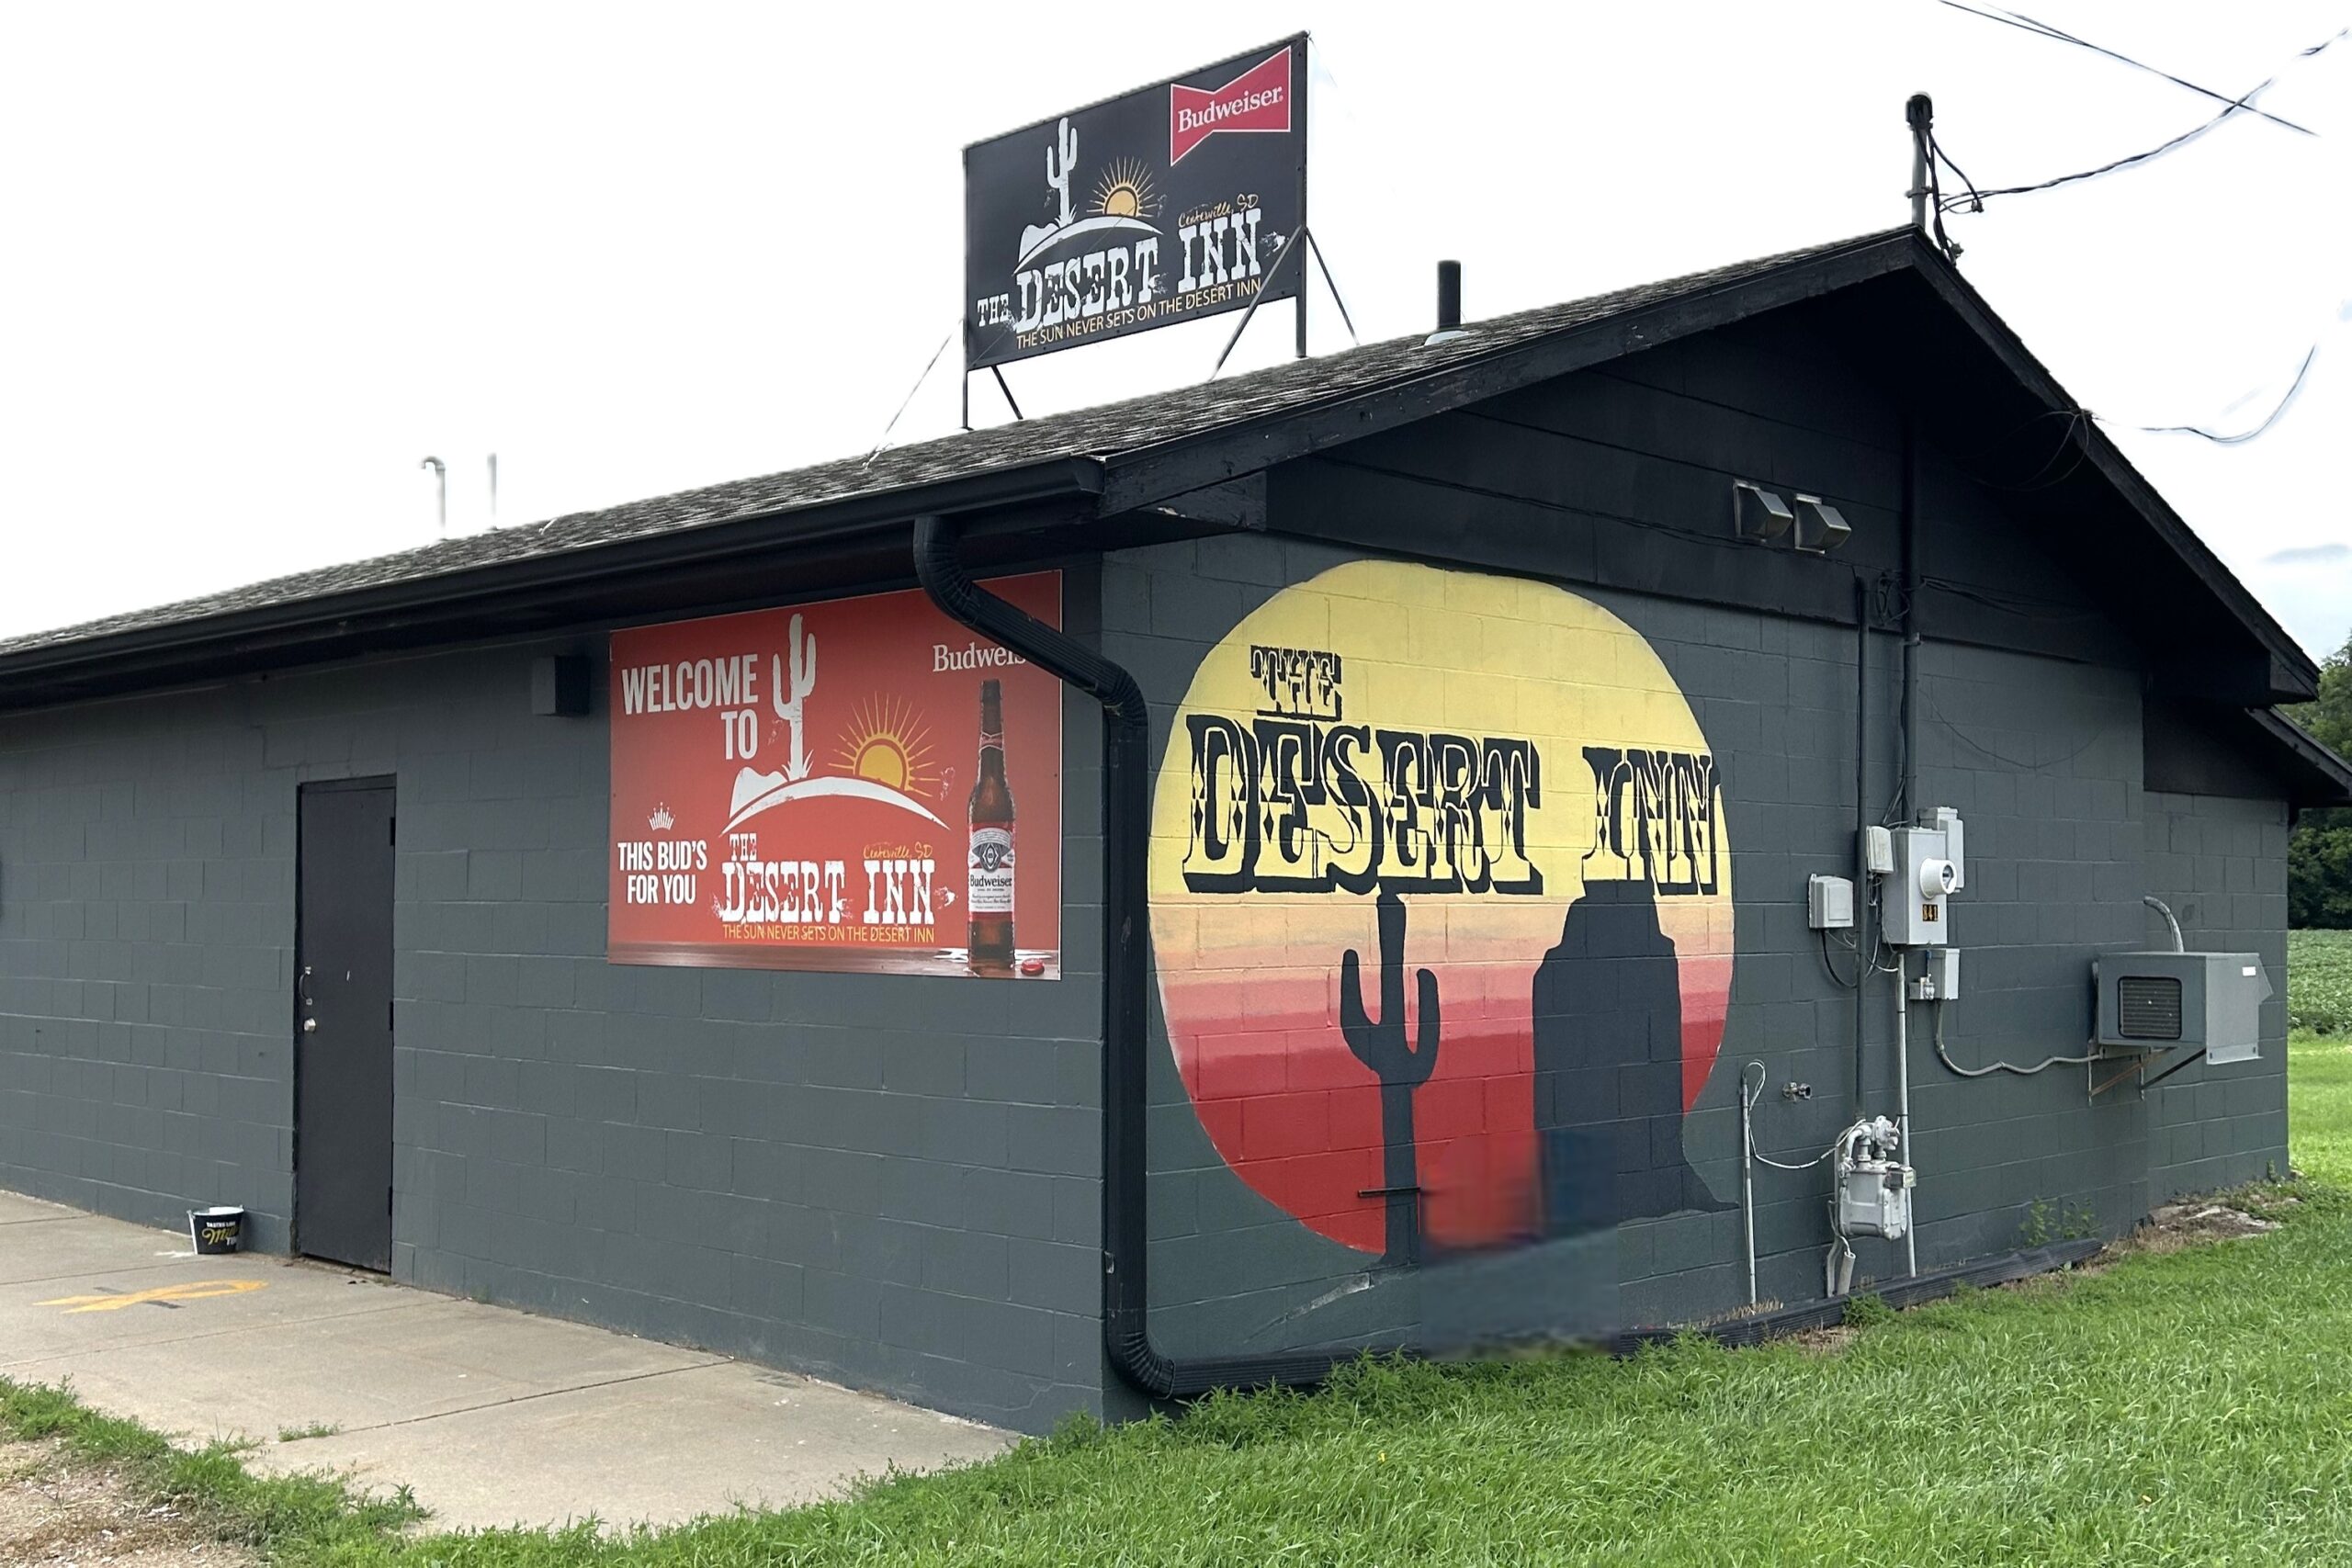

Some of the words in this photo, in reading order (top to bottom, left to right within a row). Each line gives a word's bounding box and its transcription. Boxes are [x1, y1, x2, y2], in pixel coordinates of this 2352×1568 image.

[1178, 86, 1283, 132] Budweiser
[1237, 193, 1259, 211] SD
[977, 293, 1010, 327] THE
[1014, 237, 1159, 333] DESERT
[1178, 209, 1261, 293] INN
[1017, 334, 1038, 350] THE
[1040, 326, 1063, 344] SUN
[1066, 317, 1103, 337] NEVER
[1105, 309, 1135, 329] SETS
[1137, 304, 1157, 321] ON
[1159, 296, 1182, 316] THE
[1185, 284, 1234, 310] DESERT
[1237, 277, 1261, 297] INN
[621, 654, 759, 715] WELCOME
[1250, 645, 1342, 722] THE
[721, 708, 759, 761] TO
[1182, 715, 1544, 896] DESERT
[1581, 746, 1721, 896] INN
[617, 840, 653, 871] THIS
[657, 840, 707, 871] BUD'S
[729, 833, 757, 862] THE
[914, 840, 933, 860] SD
[627, 874, 660, 904] FOR
[662, 874, 696, 904] YOU
[721, 860, 845, 925] DESERT
[864, 859, 935, 924] INN
[970, 874, 1012, 887] Budweiser
[723, 924, 742, 939] THE
[743, 924, 764, 940] SUN
[767, 925, 800, 941] NEVER
[801, 925, 827, 941] SETS
[828, 926, 845, 942] ON
[846, 926, 867, 942] THE
[869, 926, 911, 942] DESERT
[913, 927, 935, 943] INN
